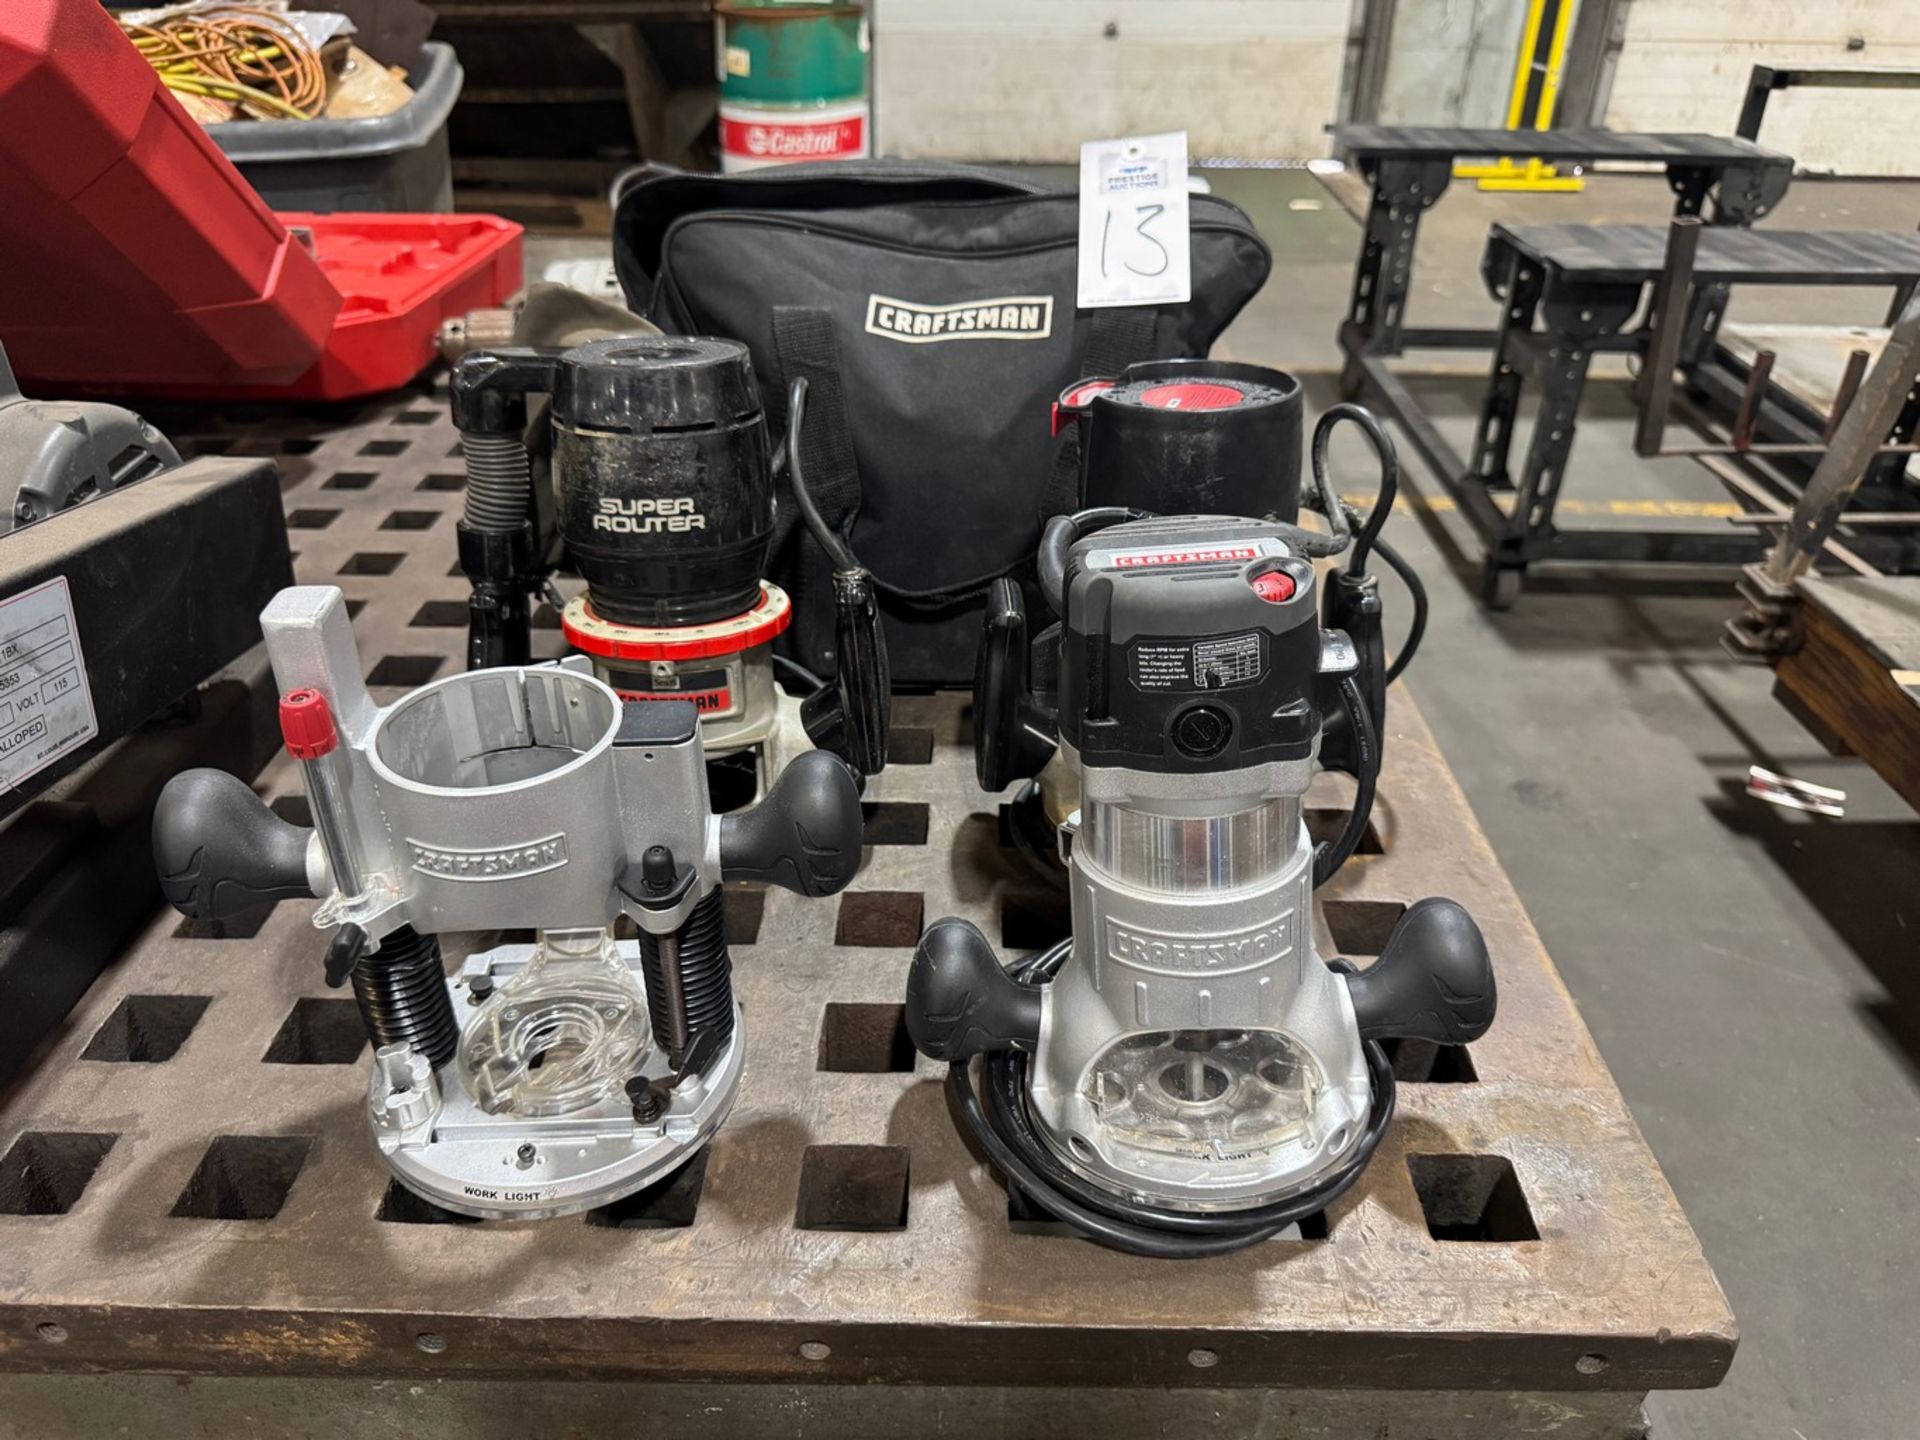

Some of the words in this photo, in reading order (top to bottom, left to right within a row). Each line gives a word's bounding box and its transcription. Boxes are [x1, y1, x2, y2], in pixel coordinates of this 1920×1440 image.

[769, 127, 838, 155] Castrol
[1108, 173, 1159, 184] PRESTIGE
[1108, 180, 1159, 191] AUCTIONS
[1101, 204, 1168, 278] 13
[877, 305, 1041, 335] CRAFTSMAN
[600, 498, 694, 515] SUPER
[593, 514, 706, 533] ROUTER
[1119, 549, 1251, 565] CRAFTSMAN
[16, 692, 40, 711] VOLT
[54, 677, 69, 692] 115
[414, 841, 559, 873] CRAFTSMAN
[1116, 924, 1286, 968] CRAFTSMAN
[464, 1186, 498, 1200] WORK
[504, 1191, 540, 1201] LIGHT
